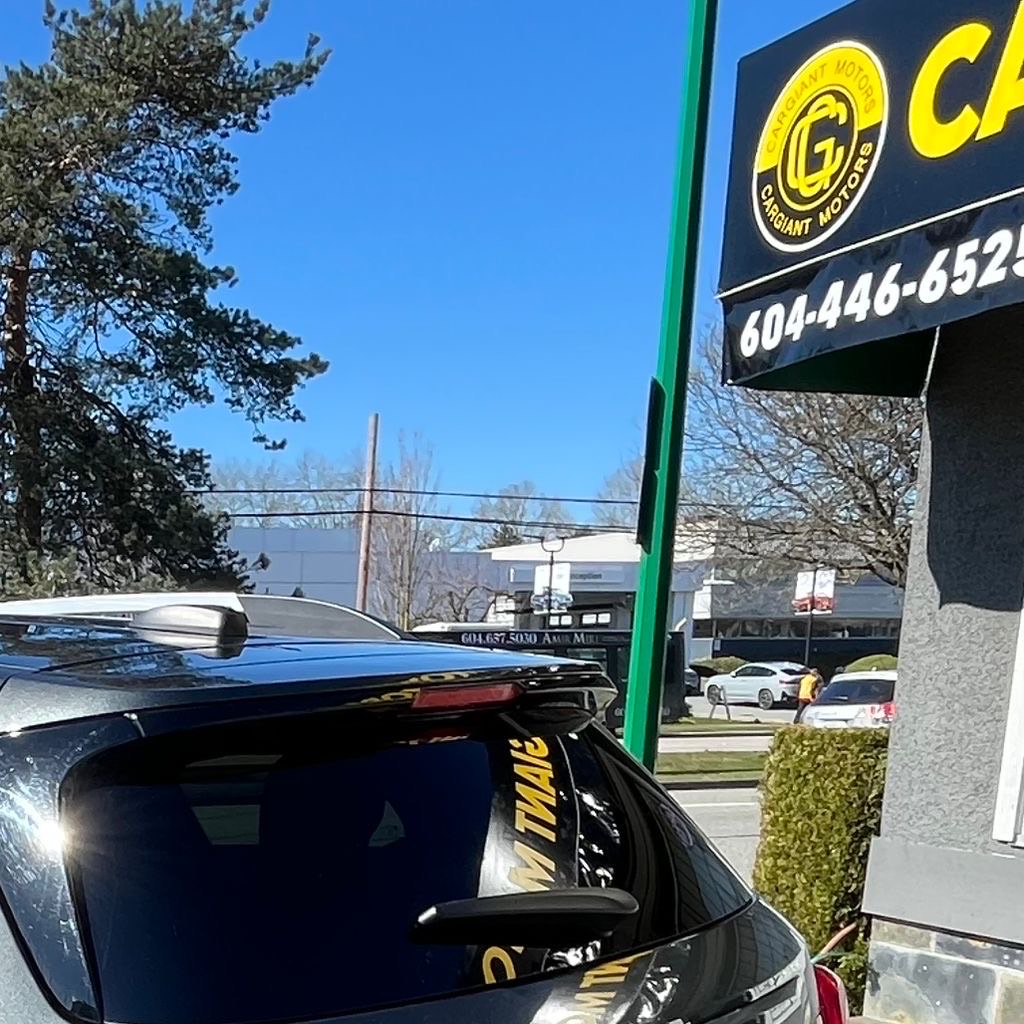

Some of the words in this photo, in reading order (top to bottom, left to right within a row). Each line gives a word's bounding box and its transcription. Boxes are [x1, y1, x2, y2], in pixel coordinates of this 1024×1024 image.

[766, 63, 828, 153] CARGIANT
[835, 59, 876, 114] MOTORS
[761, 184, 813, 236] CARGIANT
[819, 142, 873, 226] MOTORS
